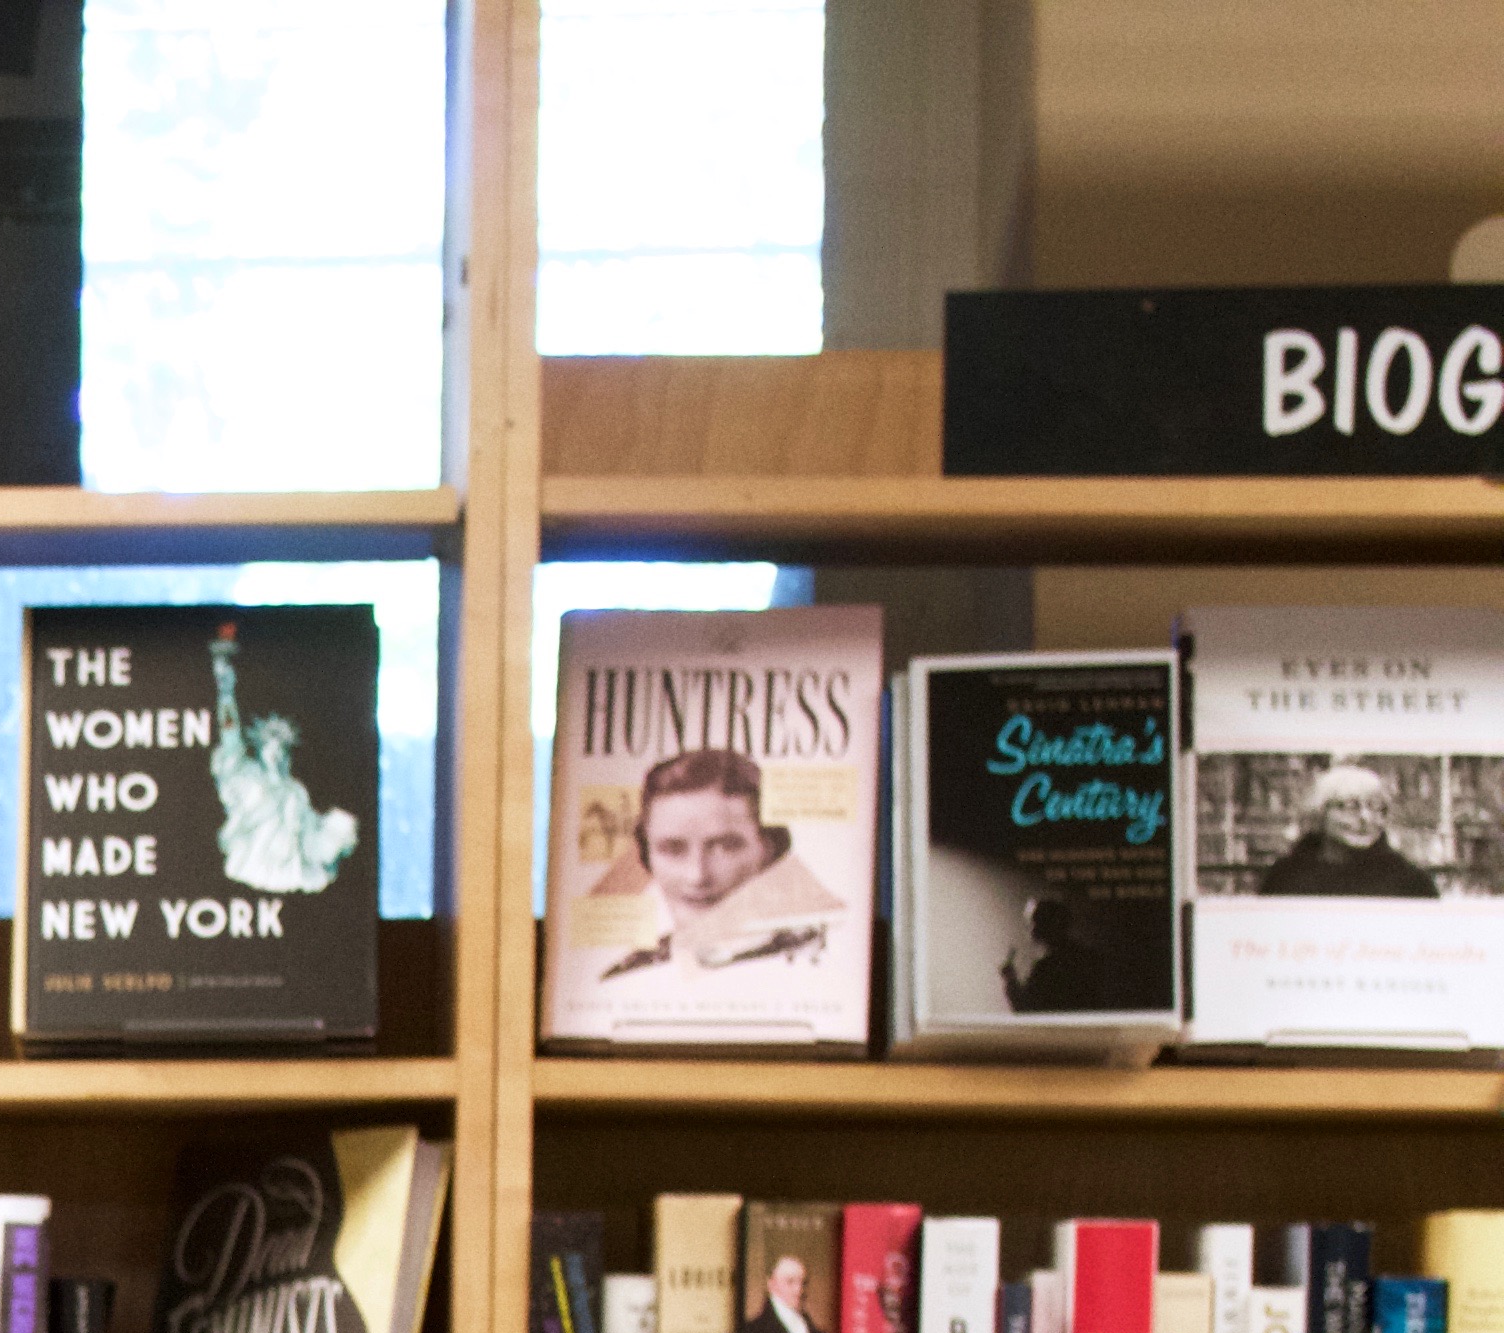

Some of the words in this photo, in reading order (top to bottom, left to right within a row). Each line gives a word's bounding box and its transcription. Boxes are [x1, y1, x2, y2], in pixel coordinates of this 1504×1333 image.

[1262, 325, 1504, 437] BIOG
[47, 646, 133, 688] THE
[45, 707, 212, 751] WOMEN
[580, 664, 852, 758] HUNTRESS
[985, 711, 1166, 776] Sinatra's
[45, 772, 160, 813] WHO
[1011, 771, 1170, 845] Century
[42, 833, 158, 878] MADE
[40, 898, 139, 941] NEW
[159, 898, 285, 940] YORK
[1322, 1258, 1345, 1294] THE
